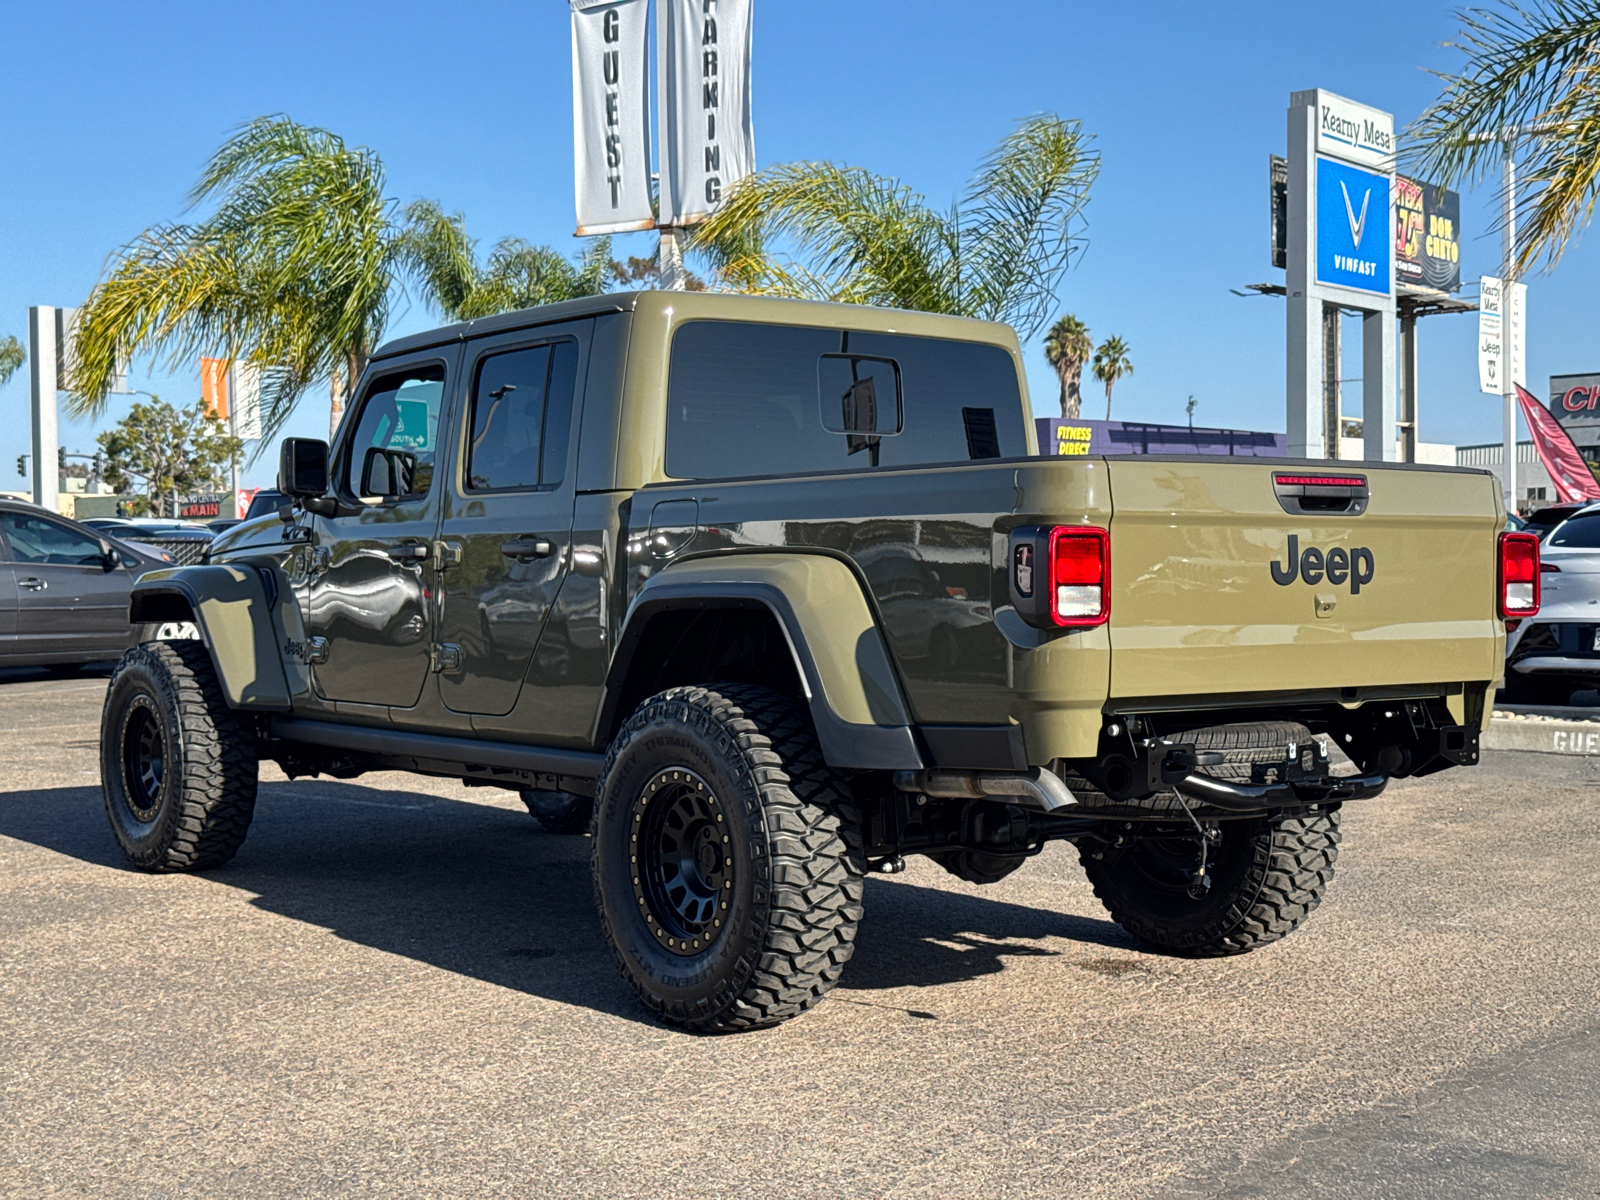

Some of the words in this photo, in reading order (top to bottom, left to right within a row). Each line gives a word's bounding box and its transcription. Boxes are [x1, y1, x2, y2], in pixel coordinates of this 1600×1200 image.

[603, 9, 621, 209] GUEST
[1322, 105, 1361, 147] Kearny
[1363, 119, 1391, 149] Mesa
[1430, 214, 1453, 241] DON
[1426, 235, 1459, 263] CHETO
[1334, 254, 1377, 276] VINFAST
[1481, 338, 1501, 357] Jeep
[390, 434, 415, 444] SOUTH
[1057, 425, 1092, 441] FITNESS
[1058, 441, 1091, 455] DIRECT
[190, 503, 219, 516] MAIN
[200, 494, 222, 503] CENTRAL
[1270, 534, 1375, 595] Jeep
[1553, 730, 1600, 754] GUE
[643, 738, 717, 775] THOMPSON
[660, 963, 716, 988] LEGEND
